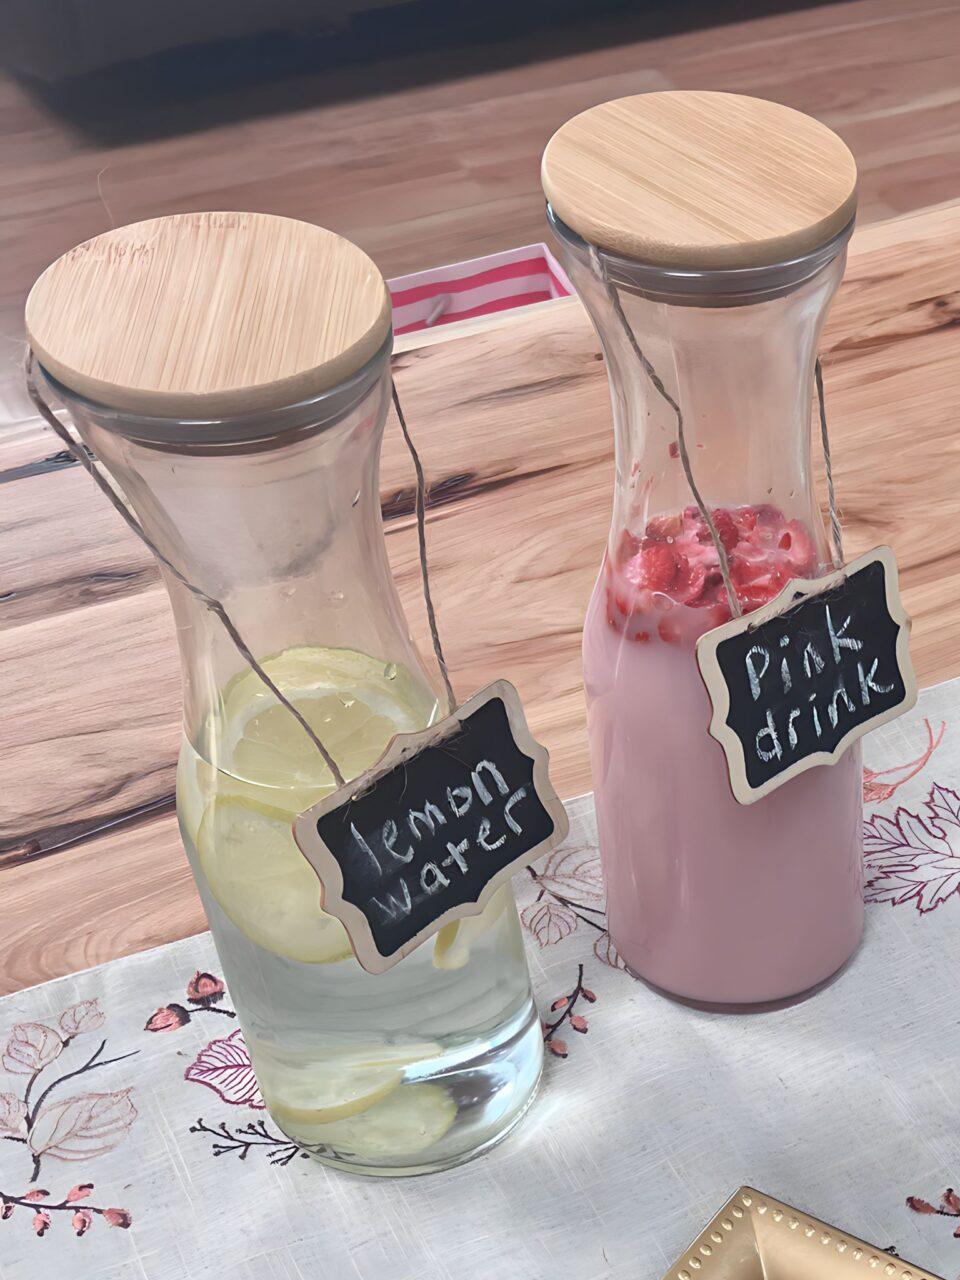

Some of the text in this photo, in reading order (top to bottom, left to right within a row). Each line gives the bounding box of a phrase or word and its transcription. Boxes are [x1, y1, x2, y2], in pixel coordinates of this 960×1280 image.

[755, 657, 894, 762] drink
[350, 759, 510, 877] lemon
[370, 786, 528, 919] water
